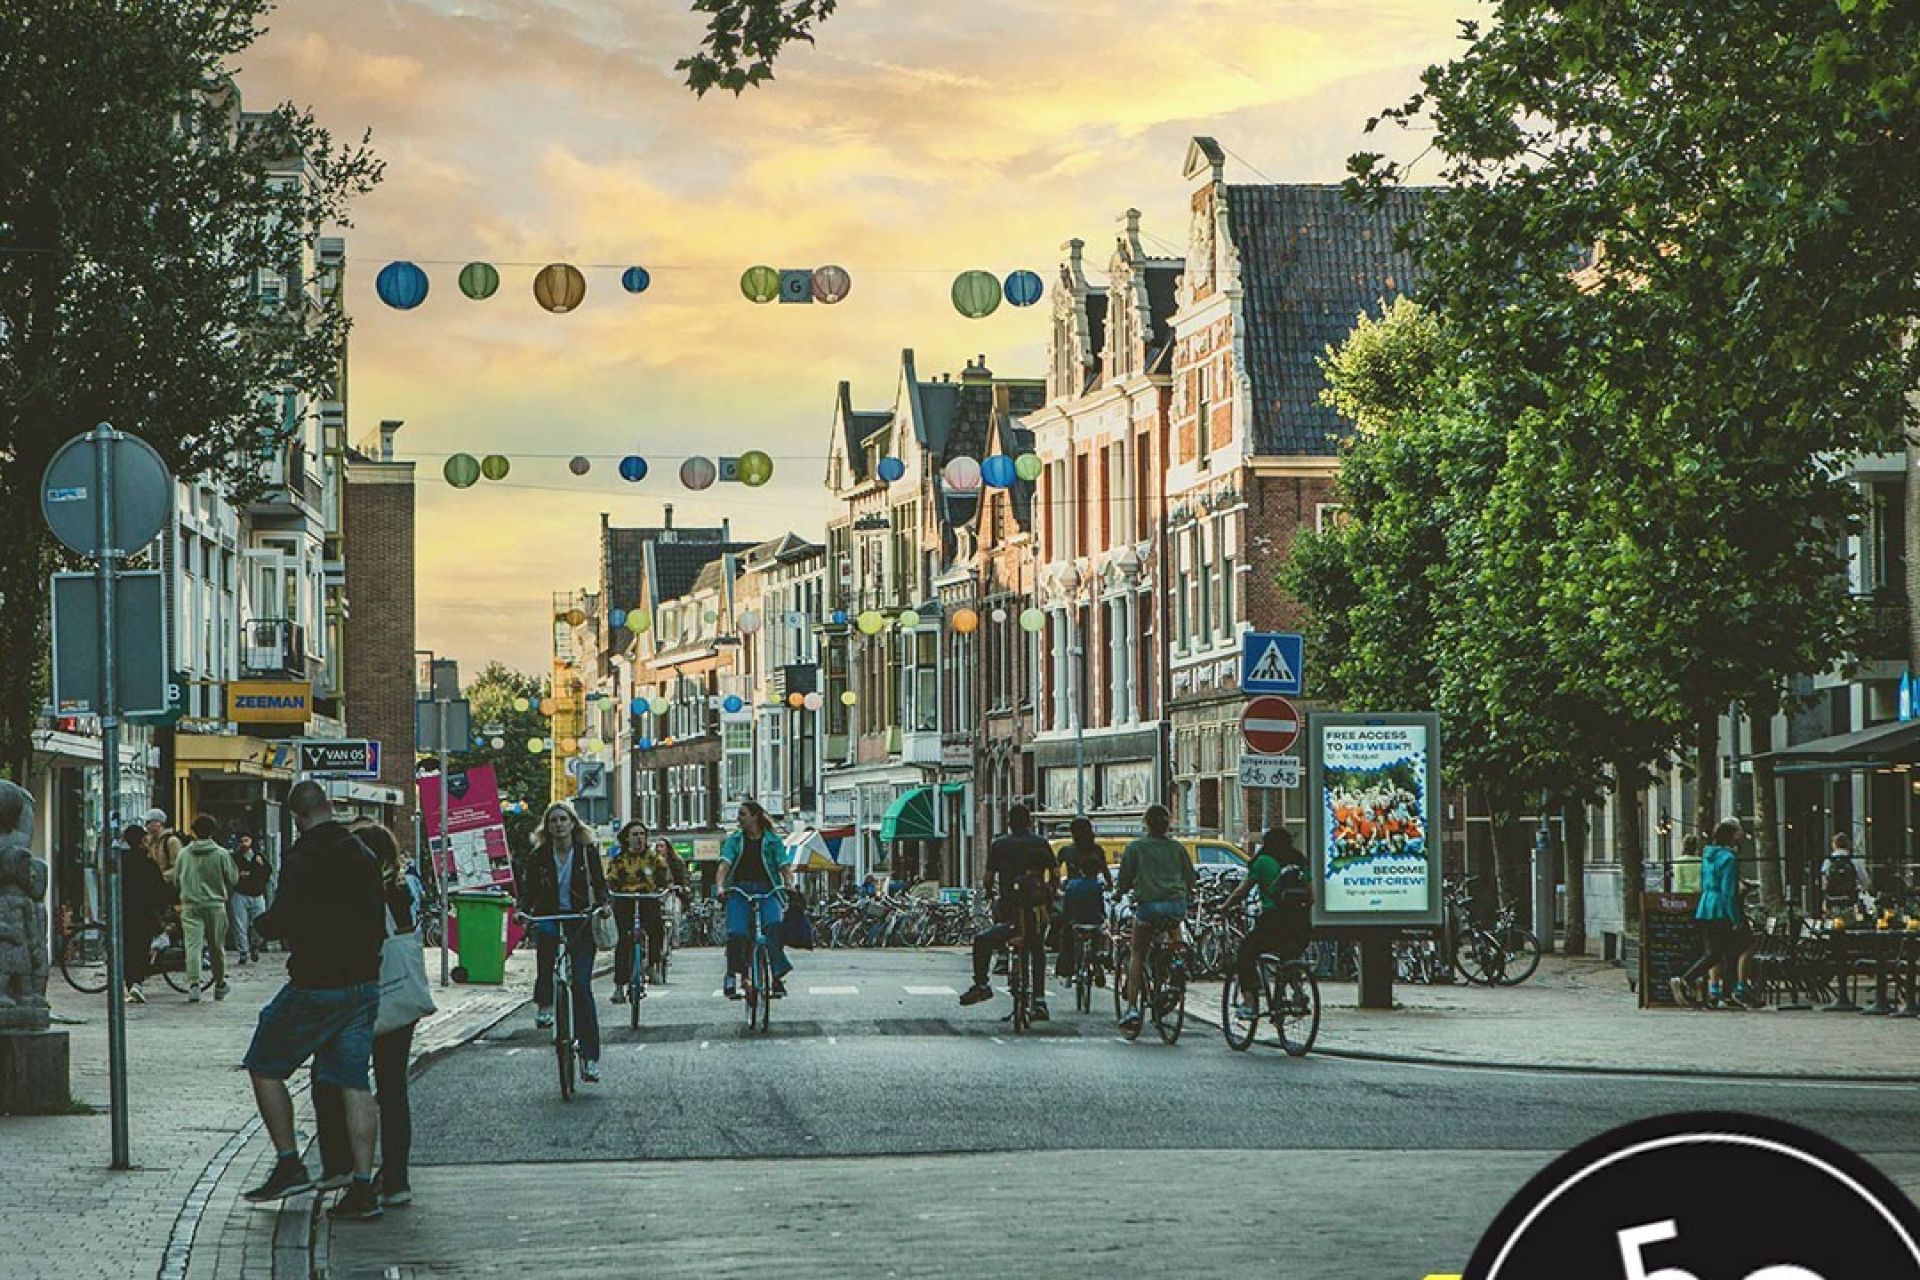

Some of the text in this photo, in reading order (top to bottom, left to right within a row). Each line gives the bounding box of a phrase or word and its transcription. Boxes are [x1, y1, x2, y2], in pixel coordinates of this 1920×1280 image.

[790, 280, 801, 293] G
[235, 695, 305, 708] ZEEMAN
[1326, 731, 1406, 740] FREE ACCESS
[1326, 742, 1343, 751] TO
[326, 749, 365, 760] VAN OS
[1373, 865, 1425, 874] BECOME
